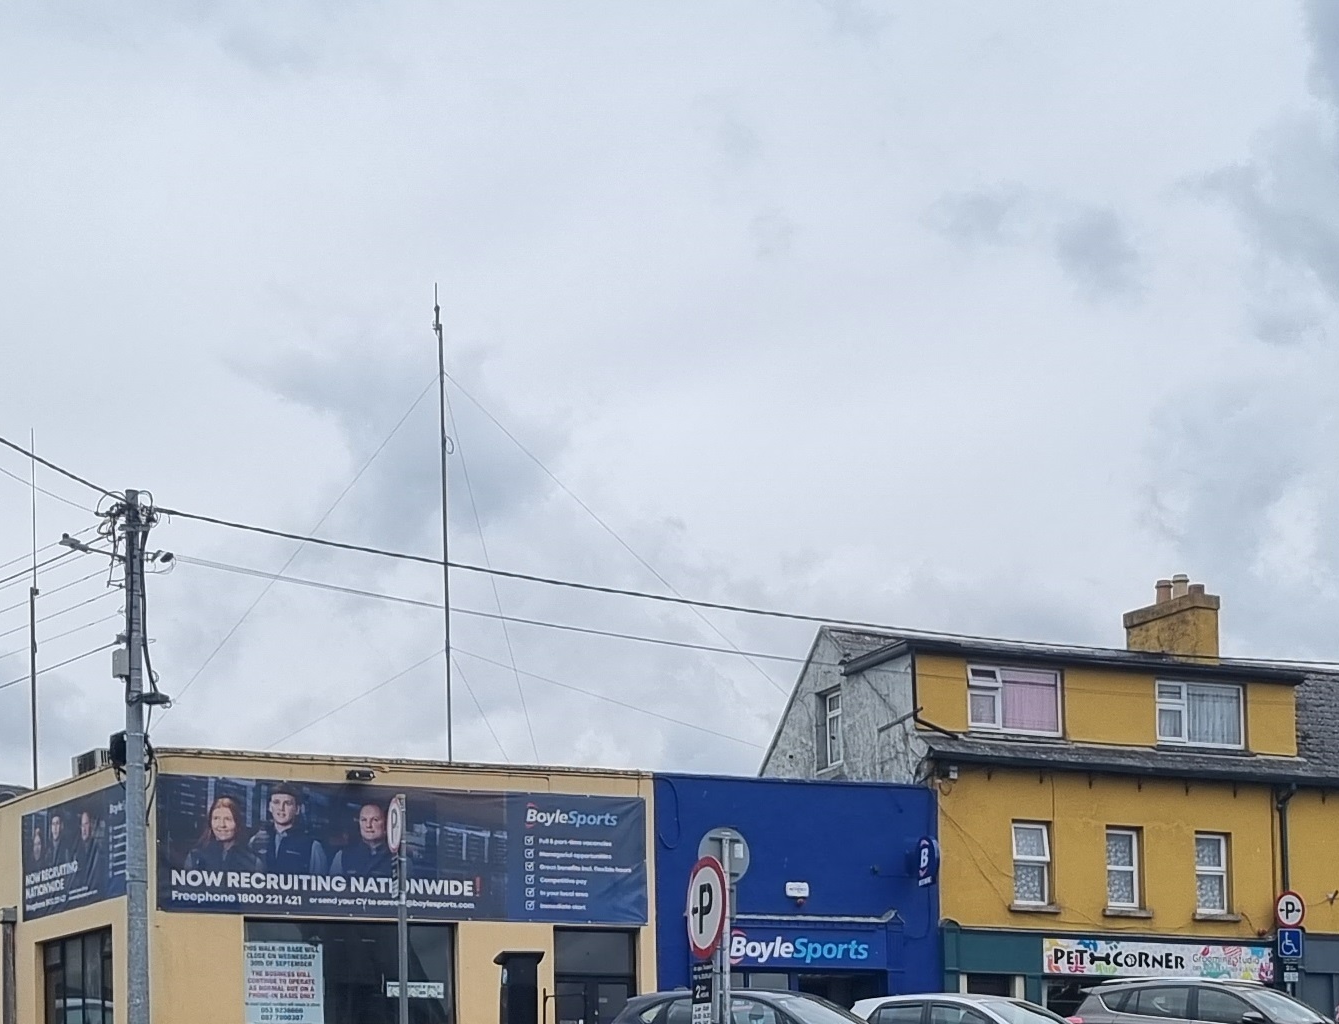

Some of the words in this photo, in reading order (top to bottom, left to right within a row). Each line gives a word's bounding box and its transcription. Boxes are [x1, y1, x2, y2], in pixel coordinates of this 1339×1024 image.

[526, 808, 618, 828] BoyleSports
[920, 847, 929, 869] B
[171, 869, 224, 888] NOW
[227, 871, 347, 892] RECRUITING
[171, 890, 236, 904] Freephone
[237, 893, 264, 904] 1800
[265, 894, 283, 905] 221
[284, 895, 302, 906] 421
[318, 897, 338, 905] send
[338, 898, 355, 906] your
[698, 883, 713, 934] P
[1285, 901, 1296, 920] P
[729, 935, 869, 964] BoyleSports
[1052, 947, 1088, 966] PET
[1112, 949, 1185, 969] CORNER
